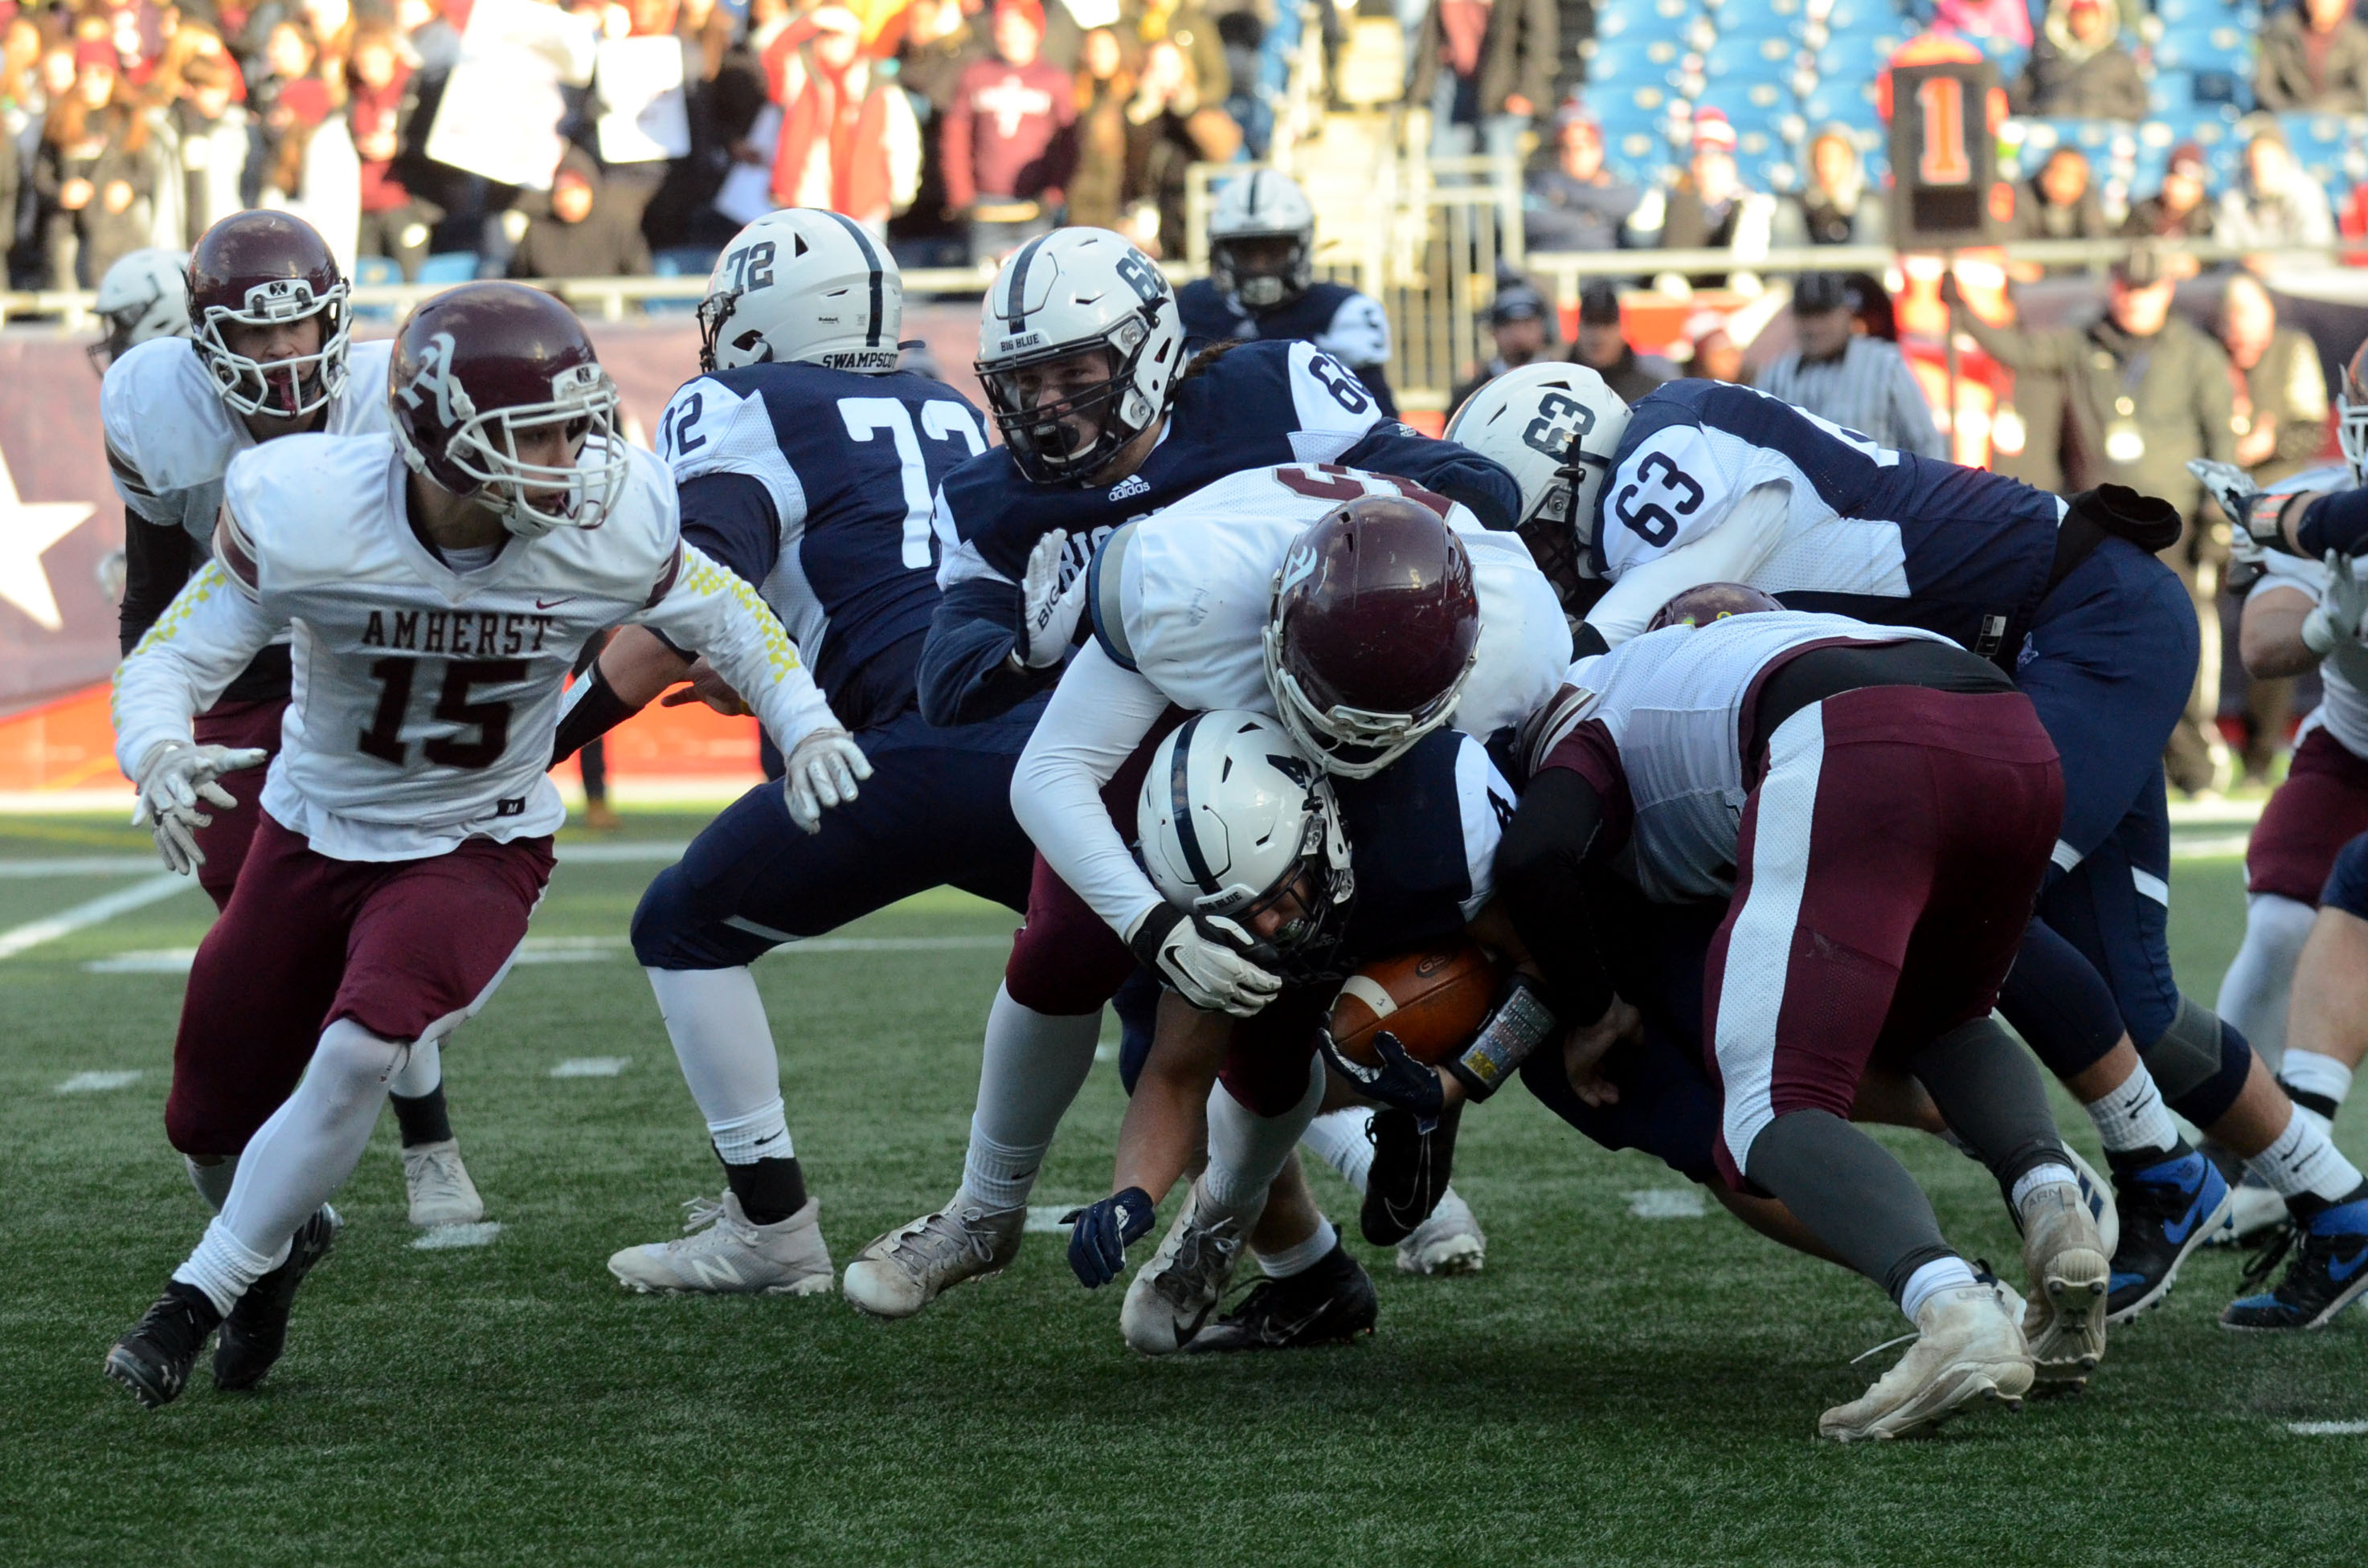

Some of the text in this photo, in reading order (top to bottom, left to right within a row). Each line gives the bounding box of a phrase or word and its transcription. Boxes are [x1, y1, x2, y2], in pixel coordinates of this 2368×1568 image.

[1916, 77, 1971, 185] 1
[726, 241, 776, 292] 72
[1000, 333, 1040, 352] BIG BLUE
[1523, 392, 1596, 464] 63
[1108, 481, 1151, 502] adidas
[1615, 451, 1704, 548] 63
[362, 610, 554, 654] AMHERST
[358, 655, 530, 769] 15
[506, 802, 517, 814] M
[1214, 891, 1243, 908] BLUE
